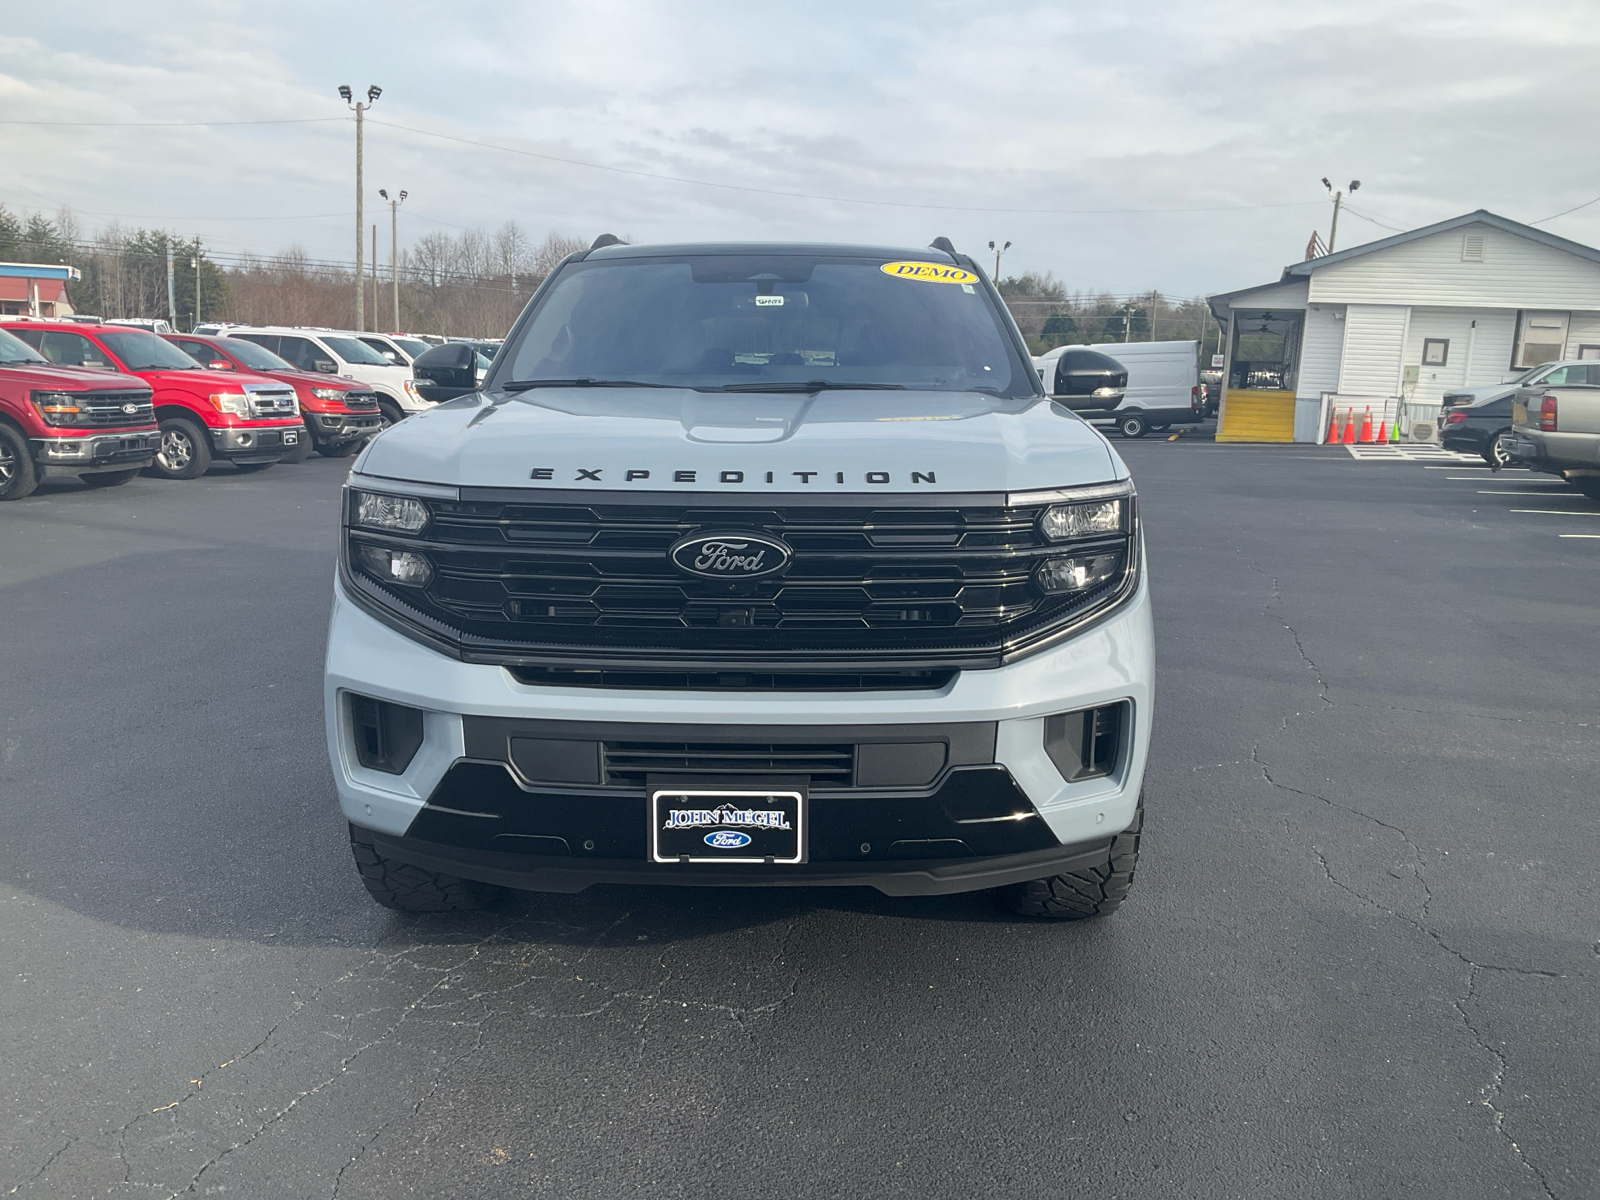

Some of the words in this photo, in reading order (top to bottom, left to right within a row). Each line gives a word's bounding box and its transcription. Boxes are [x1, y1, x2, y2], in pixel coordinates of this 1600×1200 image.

[896, 265, 968, 280] DEMO
[530, 467, 936, 484] EXPEDITION
[694, 541, 766, 571] Ford
[666, 810, 720, 828] JOHN
[722, 810, 790, 829] MEGEL
[712, 833, 742, 846] Ford
